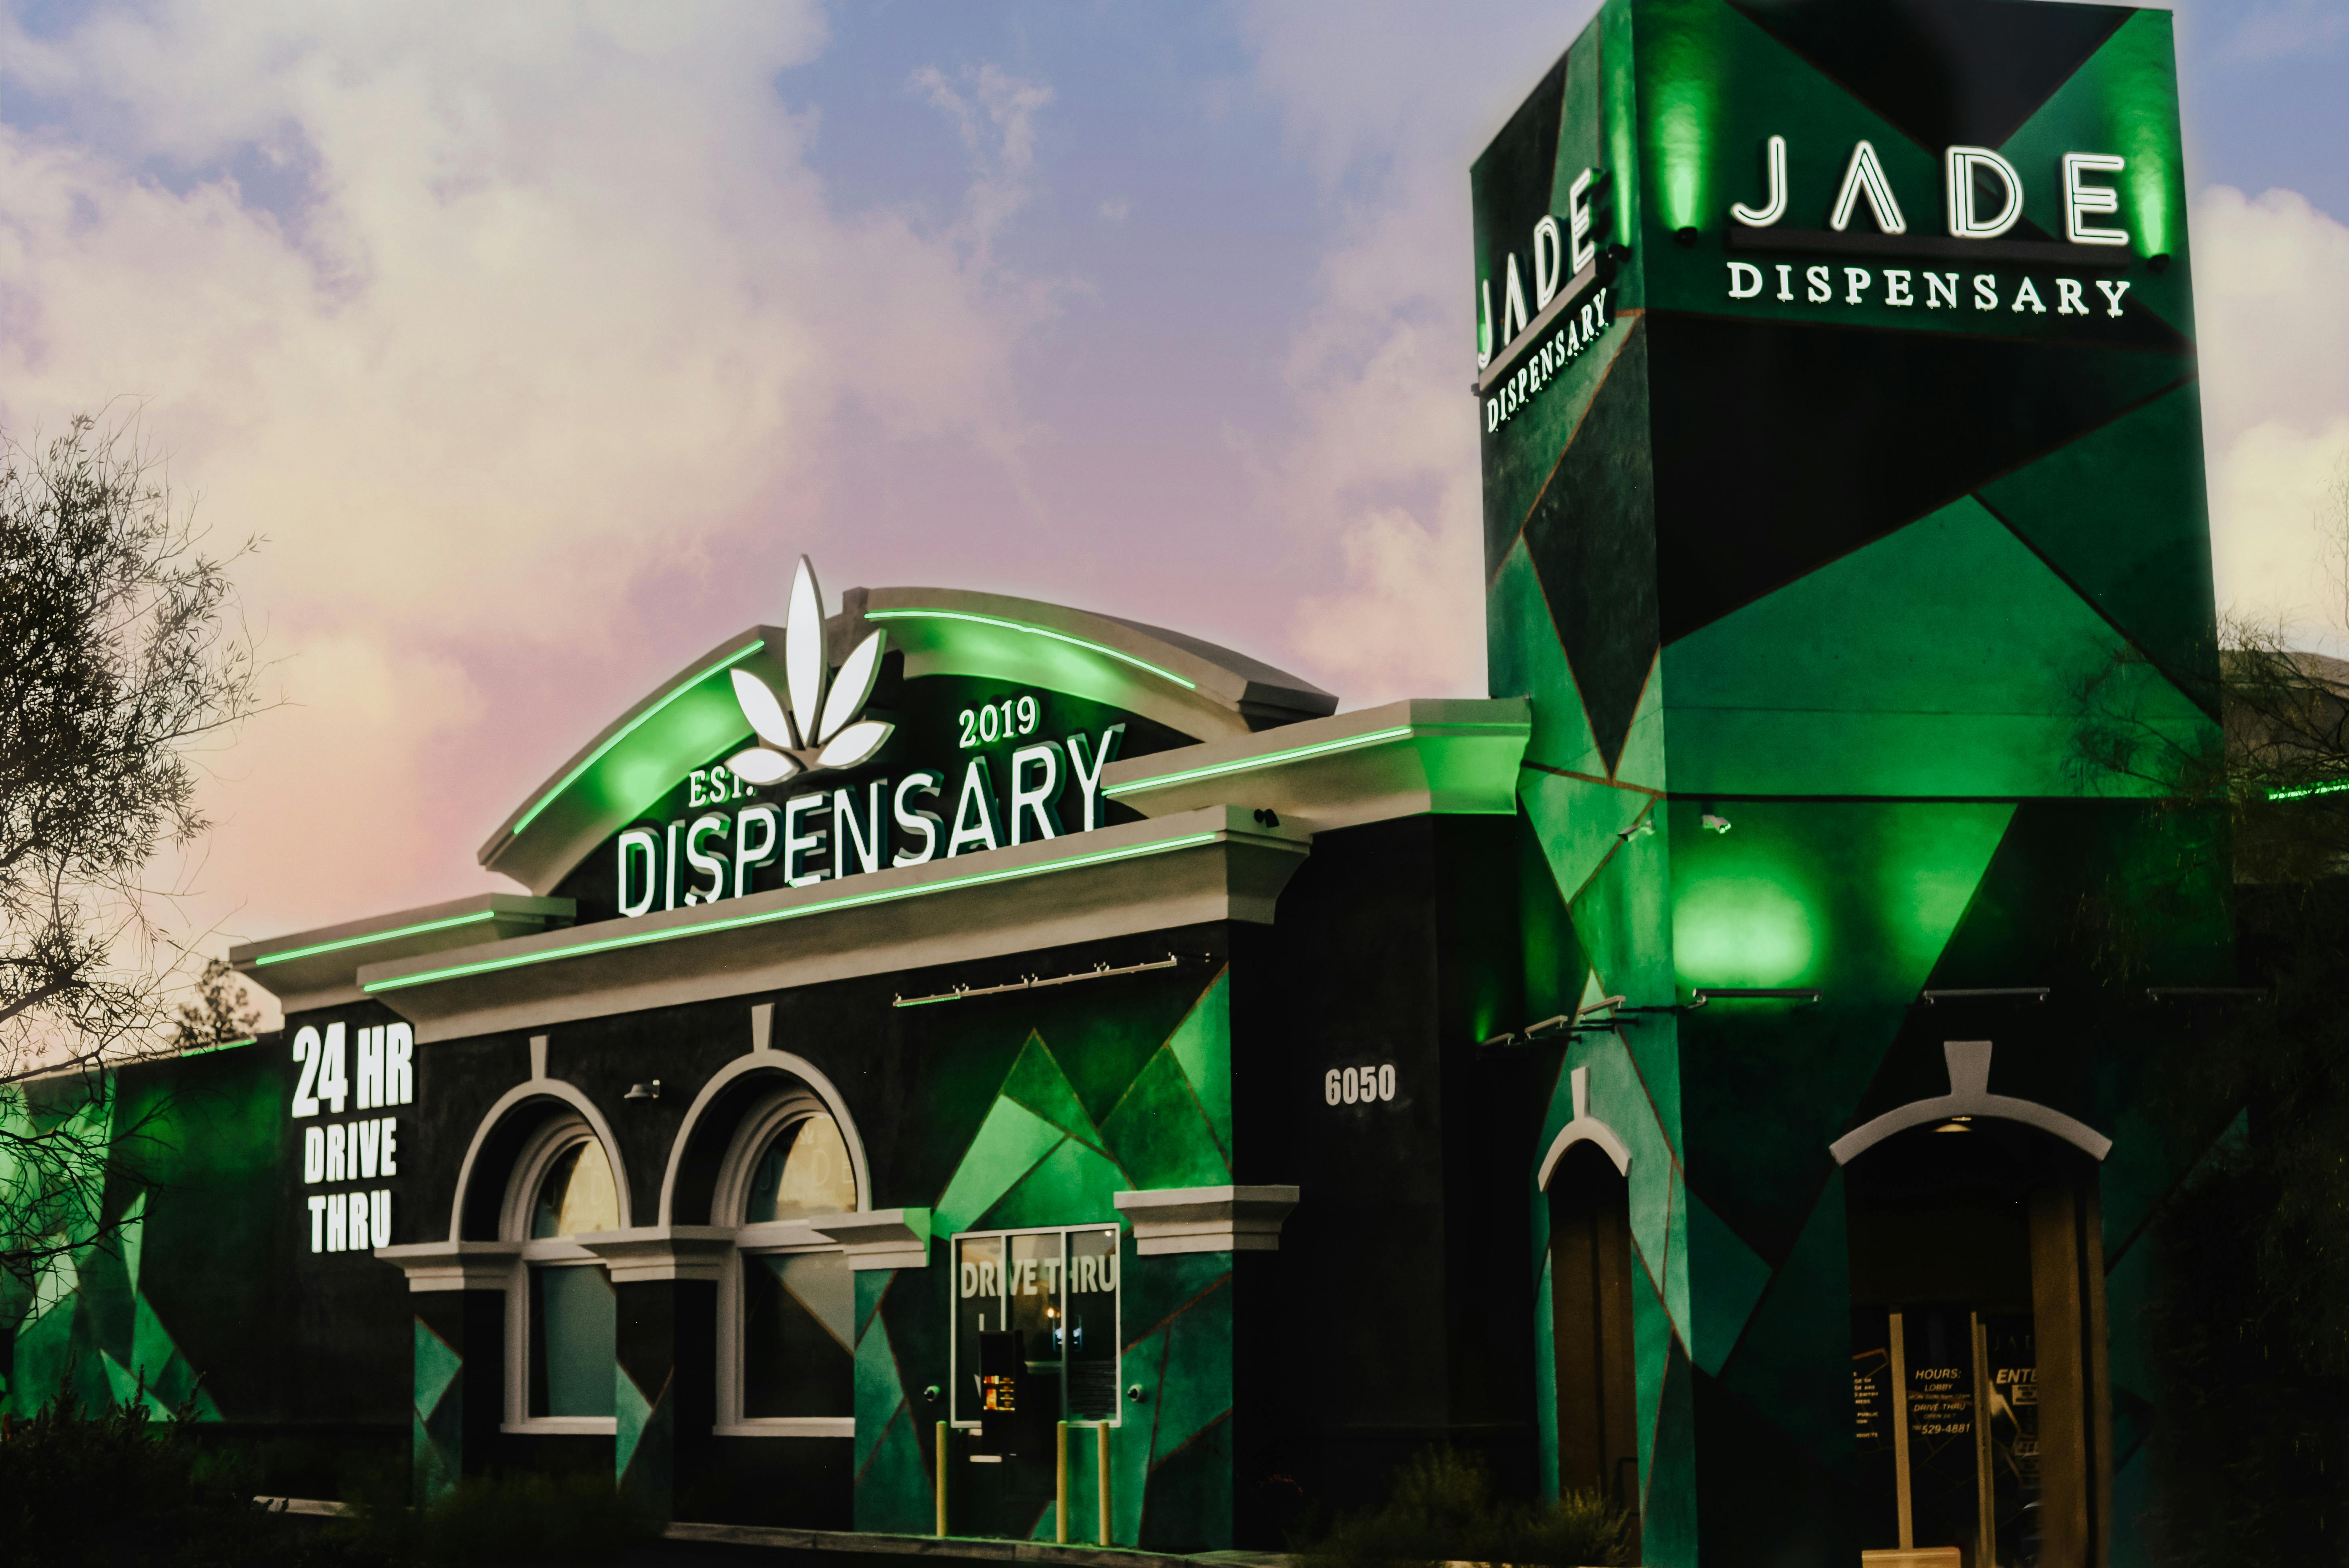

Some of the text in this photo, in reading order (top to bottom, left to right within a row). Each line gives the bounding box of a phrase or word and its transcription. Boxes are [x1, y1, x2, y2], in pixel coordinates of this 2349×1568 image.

[1731, 135, 2130, 246] JADE
[1477, 167, 1595, 369] JADE
[1726, 261, 2130, 317] DISPENSARY
[1487, 288, 1607, 433] DISPENSARY
[959, 696, 1036, 748] 2019
[618, 729, 1113, 918] DISPENSARY
[292, 1021, 413, 1118] 24 HR
[1325, 1064, 1395, 1106] 6050
[305, 1117, 396, 1184] DRIVE
[308, 1190, 391, 1253] THRU
[961, 1254, 1116, 1298] DRIVE THRU
[1915, 1368, 1961, 1380] HOURS:
[1924, 1383, 1953, 1392] LOBBY
